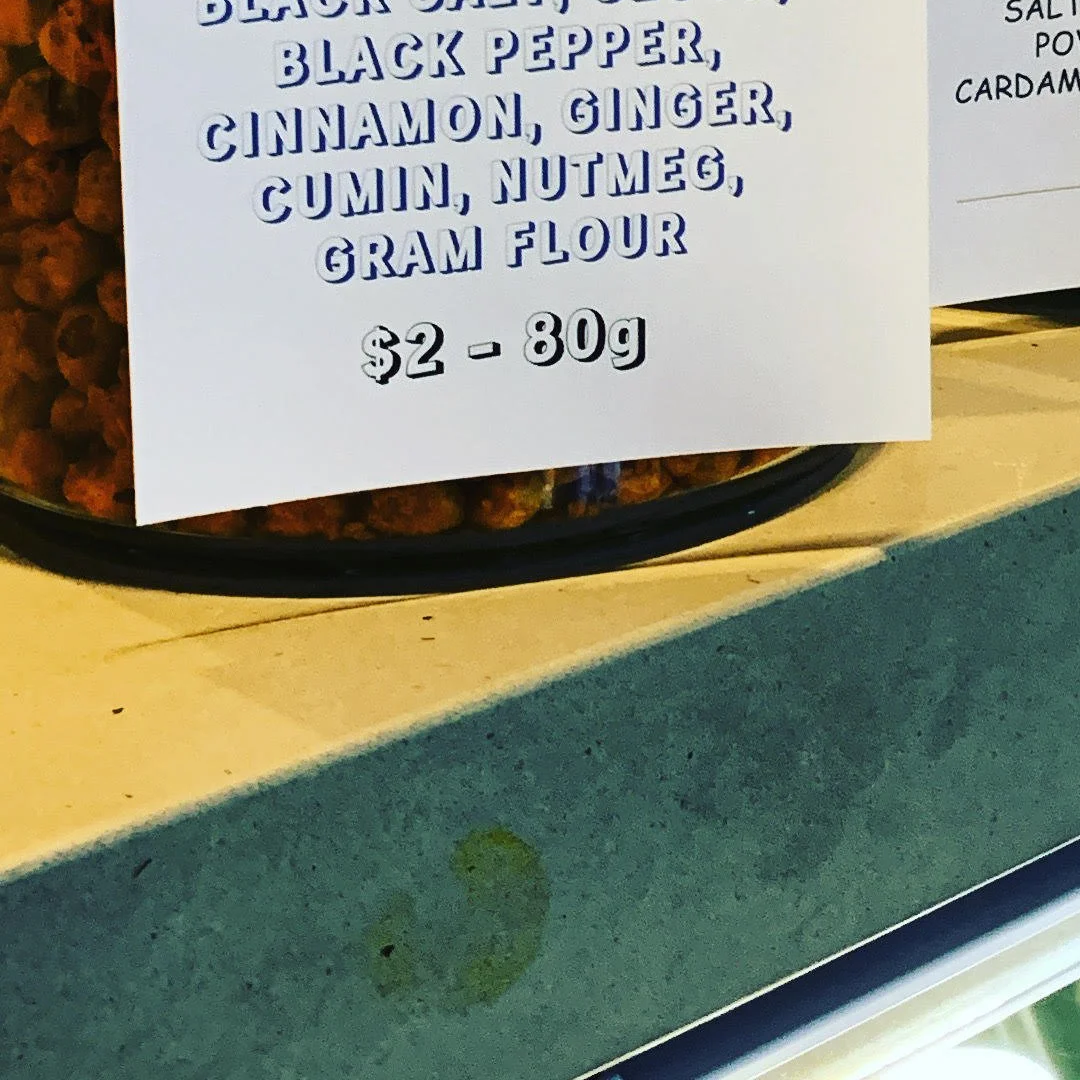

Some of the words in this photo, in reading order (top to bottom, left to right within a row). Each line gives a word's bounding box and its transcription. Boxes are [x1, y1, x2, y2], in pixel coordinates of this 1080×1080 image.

[275, 29, 466, 89] BLACK
[485, 19, 721, 75] PEPPER,
[197, 92, 542, 163] CINNAMON,
[561, 80, 792, 135] GINGER,
[255, 162, 470, 224] CUMIN,
[492, 145, 744, 205] NUTMEG,
[315, 225, 482, 284] GRAM
[506, 212, 688, 269] FLOUR
[361, 322, 445, 385] $2
[523, 307, 646, 371] 80g
